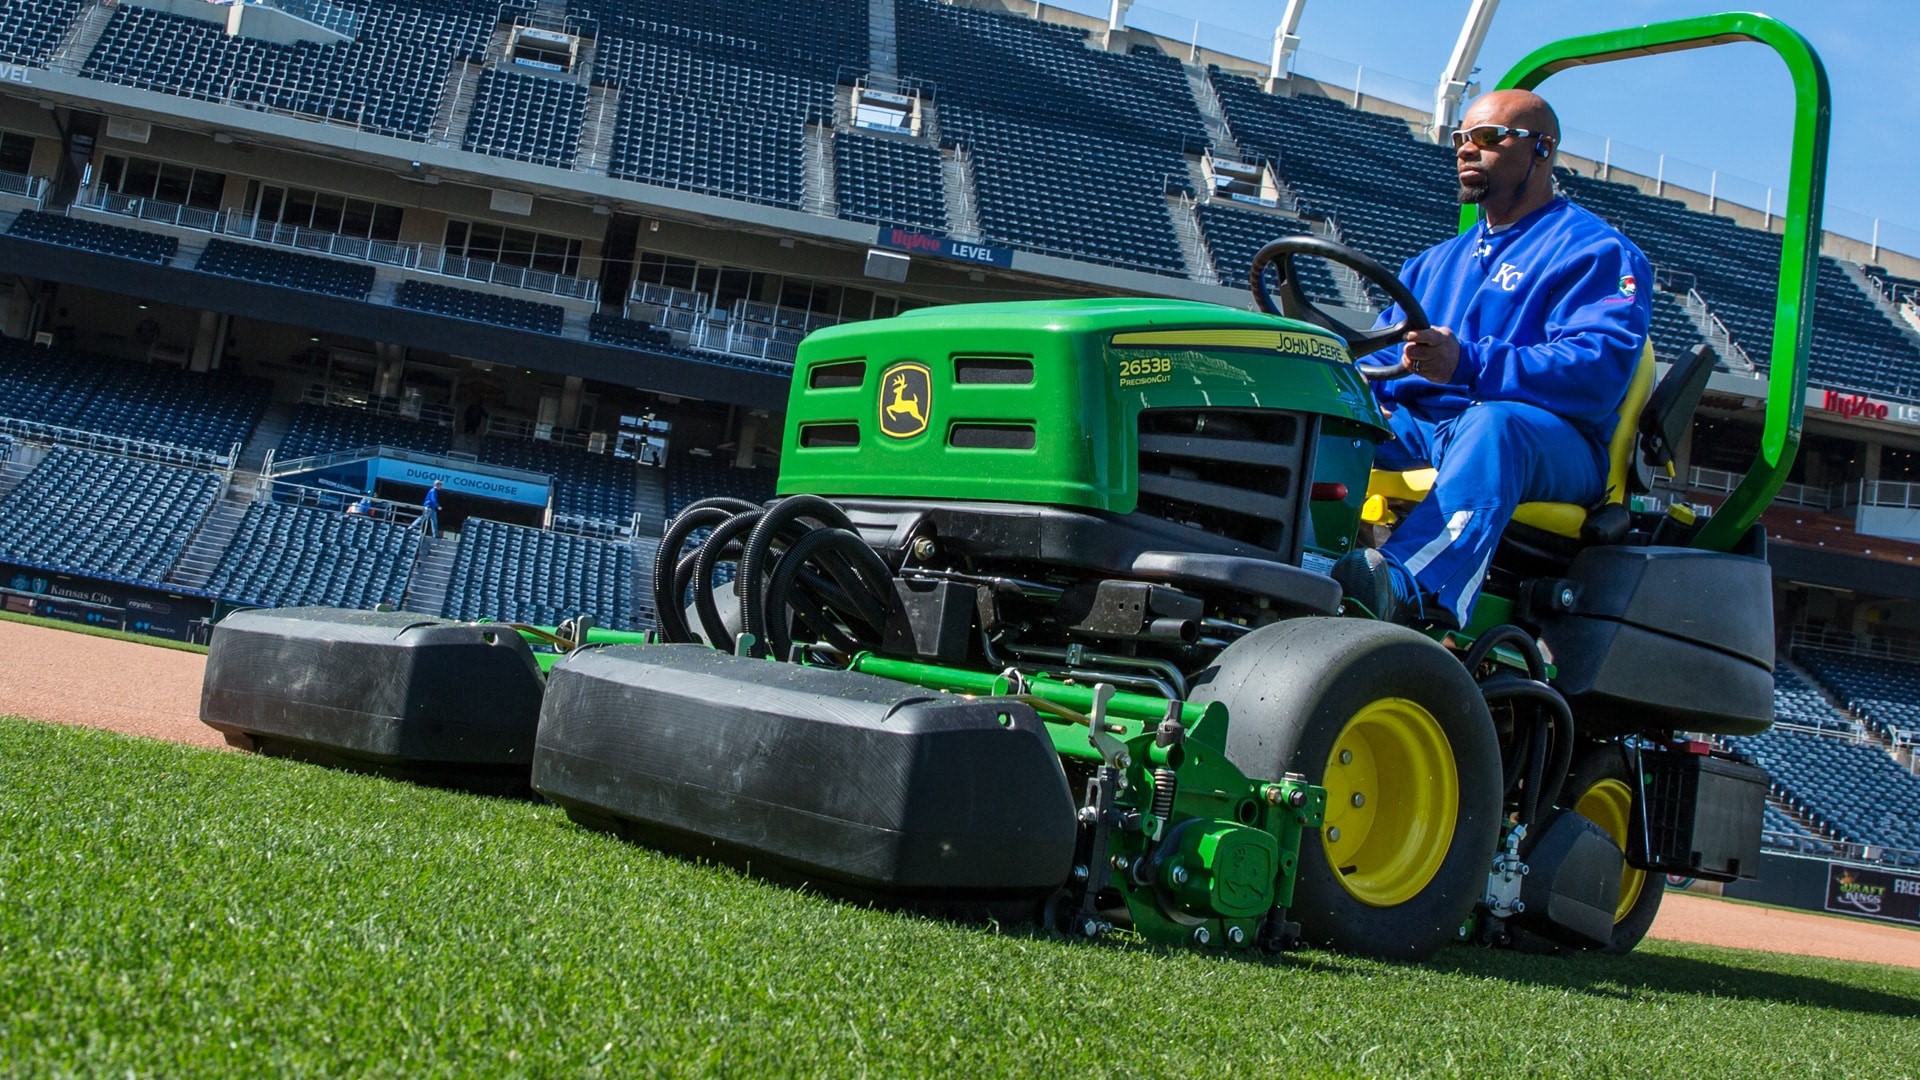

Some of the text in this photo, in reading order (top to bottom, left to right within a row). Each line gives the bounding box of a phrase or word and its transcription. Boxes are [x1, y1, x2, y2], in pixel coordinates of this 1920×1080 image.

[952, 243, 994, 262] LEVEL
[1491, 262, 1523, 292] KC
[1276, 333, 1345, 362] JOHN DEERE
[1119, 358, 1171, 377] 2653B
[406, 468, 518, 496] DUGOUT CONCOURSE
[50, 584, 114, 606] Kansas City
[1840, 879, 1920, 897] DRAFT FREE
